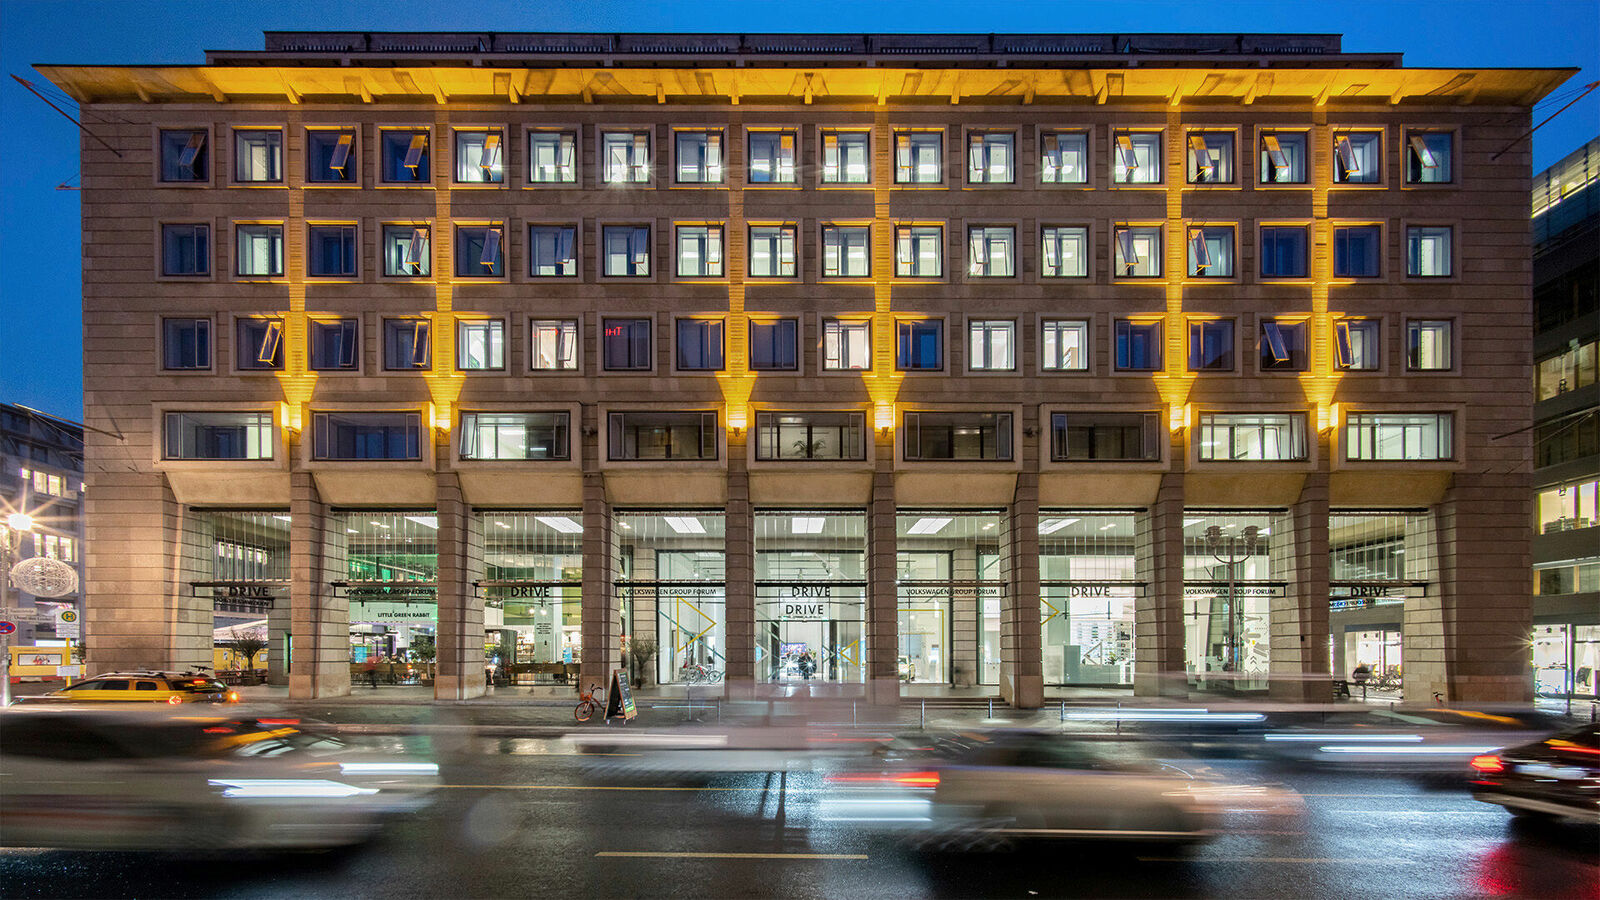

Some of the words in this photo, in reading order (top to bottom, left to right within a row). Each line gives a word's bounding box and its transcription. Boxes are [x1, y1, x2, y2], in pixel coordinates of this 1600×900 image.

[230, 586, 269, 596] DRIVE
[511, 586, 549, 597] DRIVE
[792, 586, 830, 597] DRIVE
[1072, 586, 1110, 597] DRIVE
[1351, 586, 1389, 597] DRIVE
[786, 605, 823, 614] DRIVE
